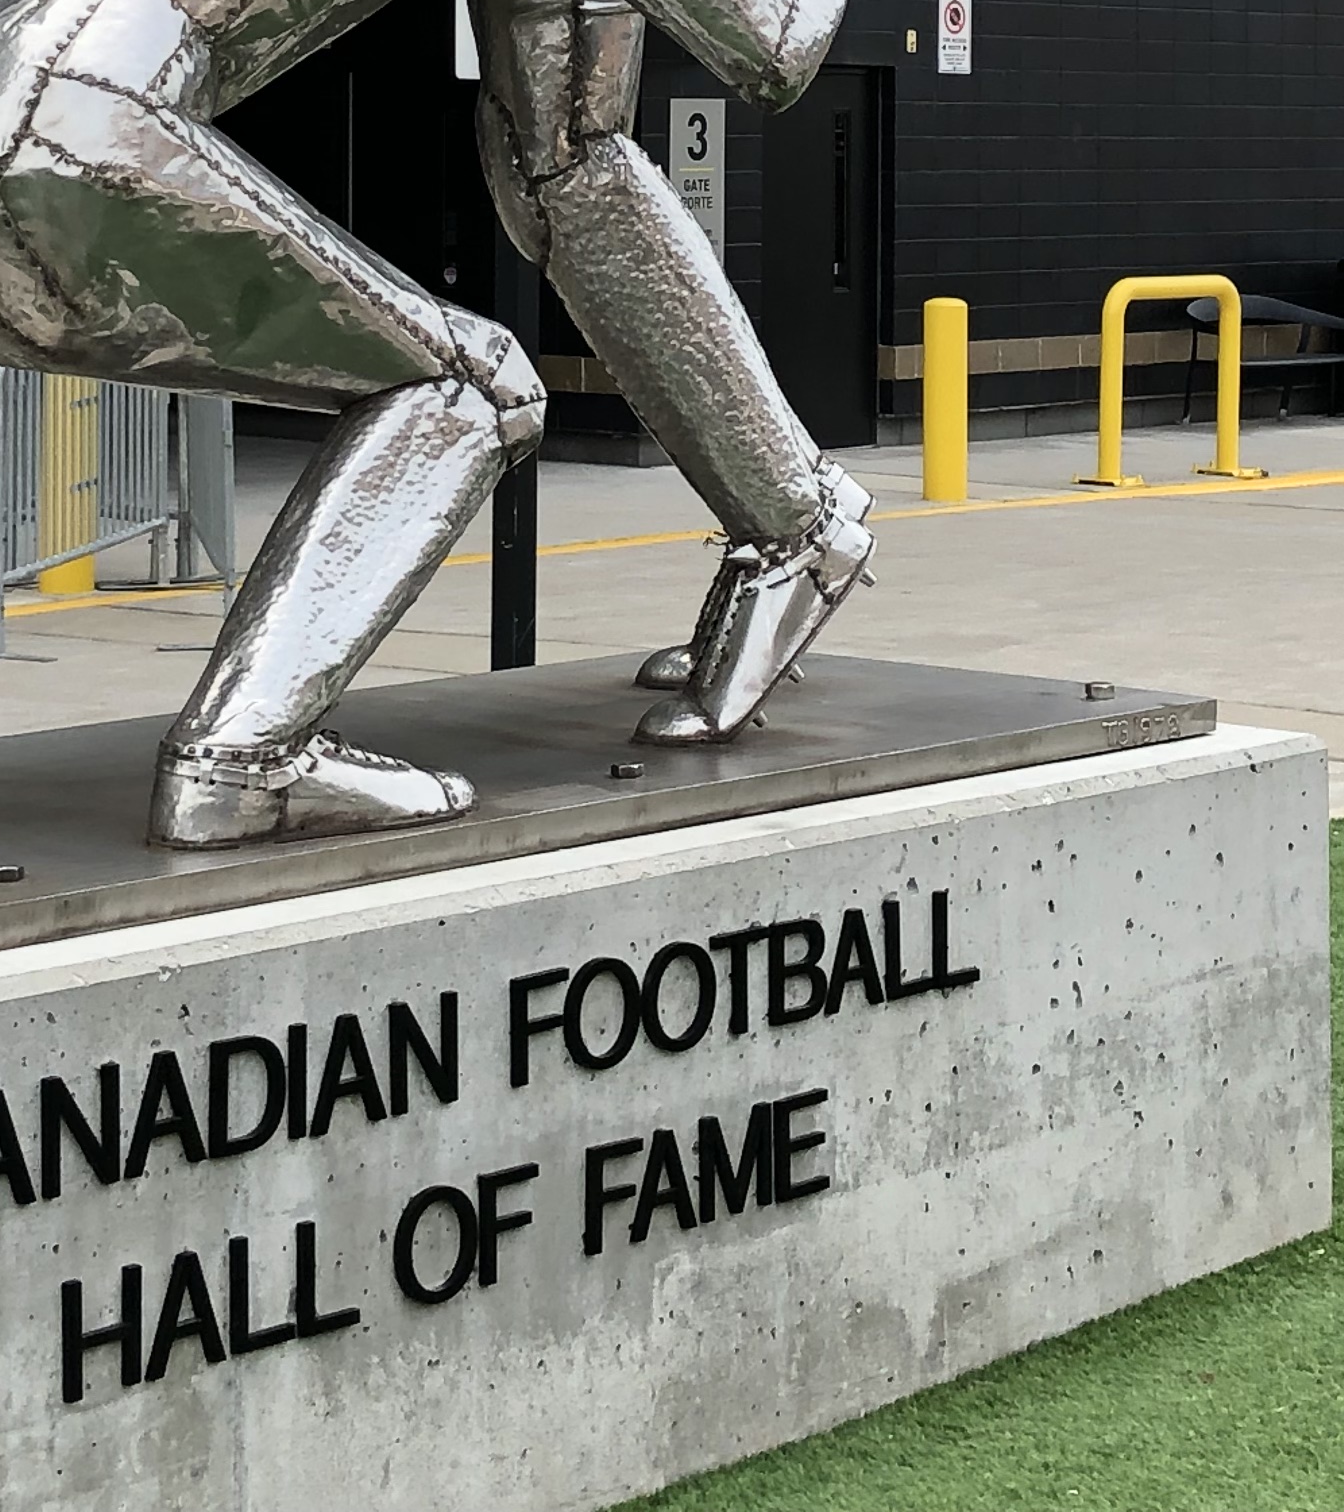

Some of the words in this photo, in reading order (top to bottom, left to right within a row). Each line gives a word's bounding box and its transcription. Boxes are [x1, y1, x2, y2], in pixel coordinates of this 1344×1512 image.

[683, 178, 711, 192] GATE
[686, 112, 708, 162] 3
[510, 890, 981, 1089] FOOTBALL
[60, 1220, 361, 1404] HALL
[392, 1162, 539, 1306] OF
[582, 1087, 831, 1257] FAME
